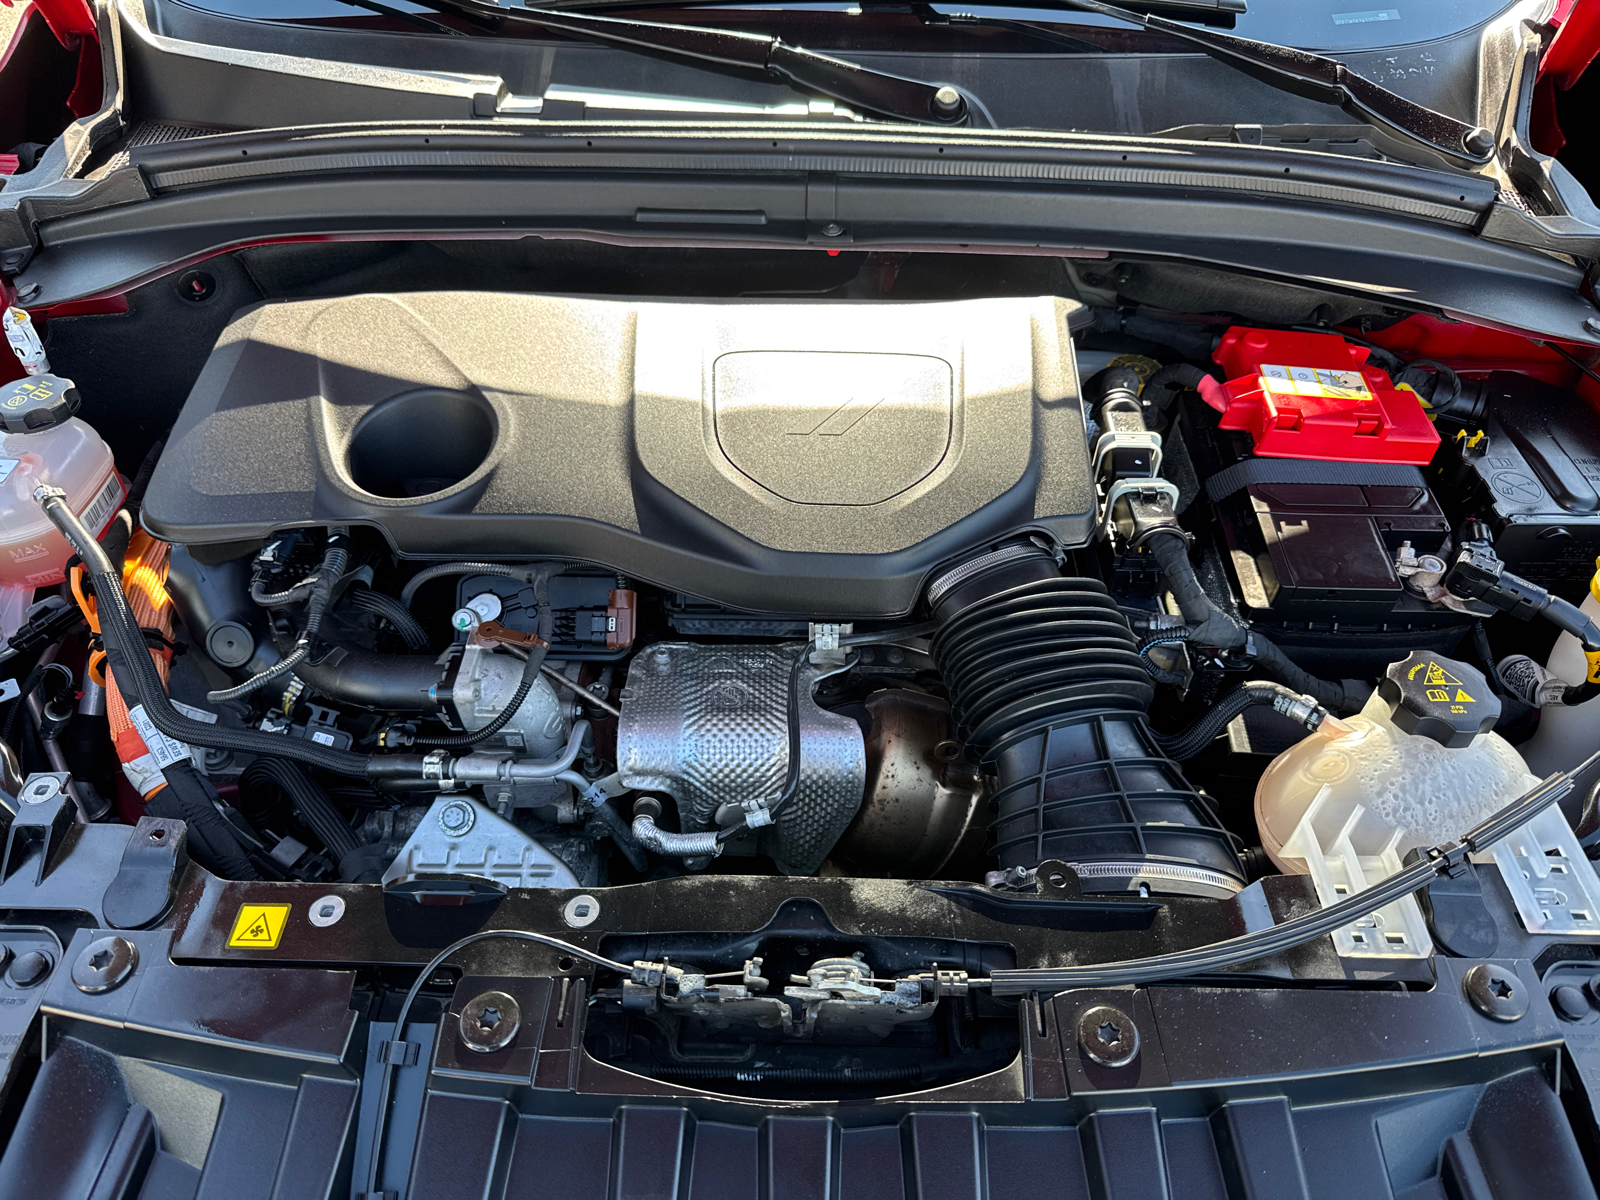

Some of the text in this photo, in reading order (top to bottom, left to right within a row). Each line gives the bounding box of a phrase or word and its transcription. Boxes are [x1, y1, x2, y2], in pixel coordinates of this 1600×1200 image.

[9, 543, 47, 559] MAX
[27, 570, 66, 586] MIN
[588, 787, 607, 803] 214
